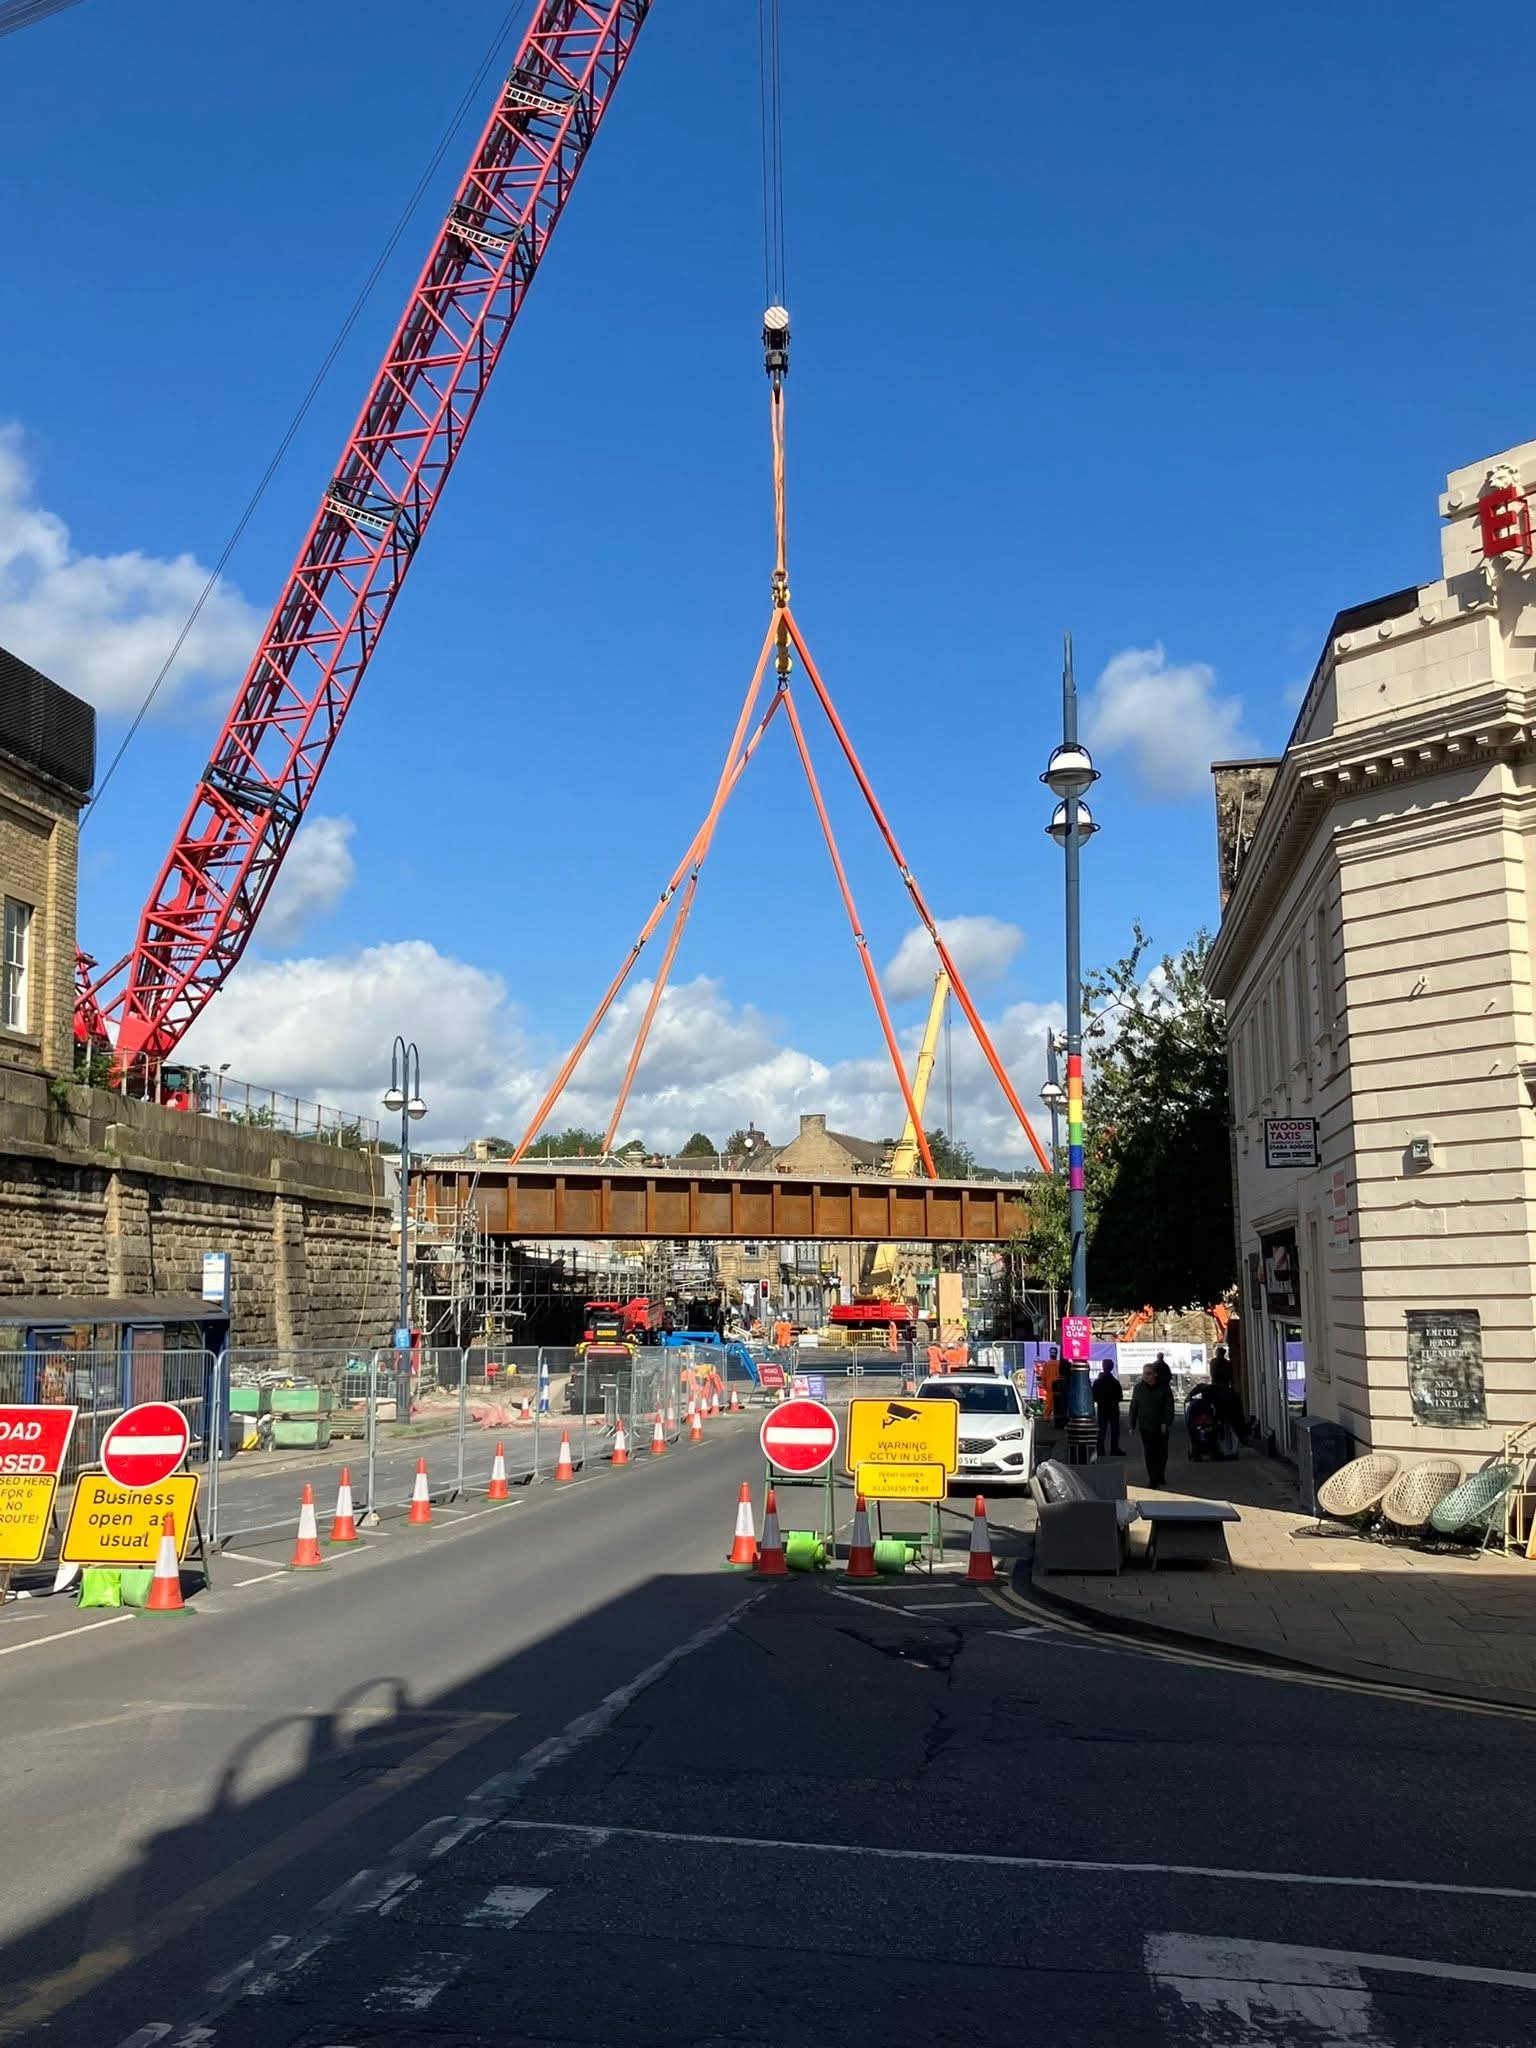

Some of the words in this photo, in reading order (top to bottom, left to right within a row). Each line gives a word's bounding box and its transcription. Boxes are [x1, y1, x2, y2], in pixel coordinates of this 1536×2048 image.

[1269, 1122, 1312, 1131] WOODS
[1270, 1131, 1301, 1140] TAXIS
[1425, 1328, 1459, 1337] EMPIRE
[1429, 1339, 1457, 1347] HOUSE
[1434, 1390, 1459, 1398] USED
[1428, 1400, 1470, 1408] VINTAGE
[878, 1441, 927, 1450] WARNING
[869, 1453, 897, 1461] CCTV
[900, 1453, 910, 1461] IN
[913, 1453, 934, 1462] USE
[23, 1477, 52, 1486] HERE
[1, 1489, 24, 1498] FOR
[93, 1489, 175, 1505] Business
[6, 1502, 23, 1511] NO
[88, 1513, 133, 1528] open
[100, 1532, 149, 1547] usual
